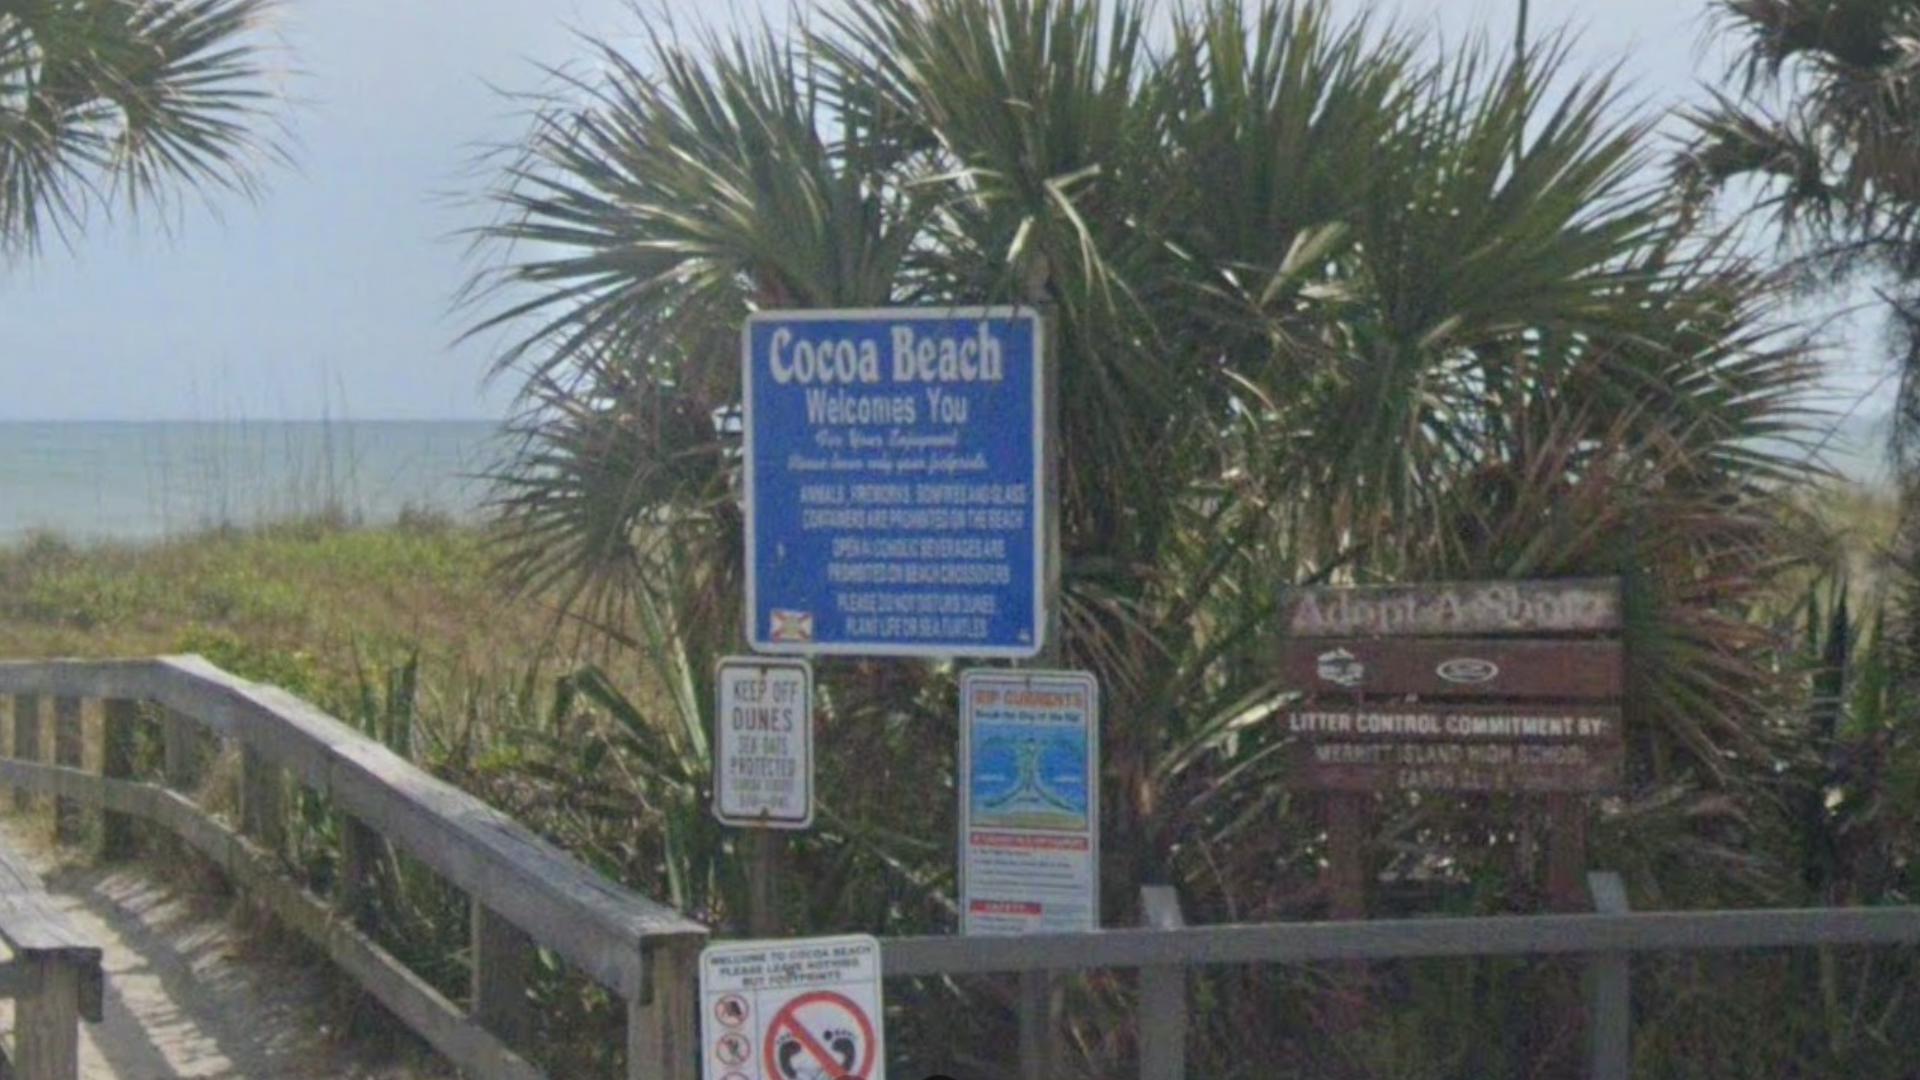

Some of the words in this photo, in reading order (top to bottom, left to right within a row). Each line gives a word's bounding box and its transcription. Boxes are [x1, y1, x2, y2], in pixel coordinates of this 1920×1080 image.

[769, 327, 880, 384] Cocoa
[891, 321, 1003, 383] Beach
[806, 388, 917, 425] Welcomes
[926, 387, 968, 424] You
[733, 680, 767, 702] KEEP
[772, 681, 798, 703] OFF
[732, 707, 793, 732] DUNES
[1289, 713, 1349, 733] LITTER
[1356, 713, 1441, 733] CONTROL
[1445, 714, 1572, 735] COMMITMENT
[730, 756, 796, 777] PROTECTED
[789, 950, 829, 961] COCOA
[833, 946, 872, 957] BEACH
